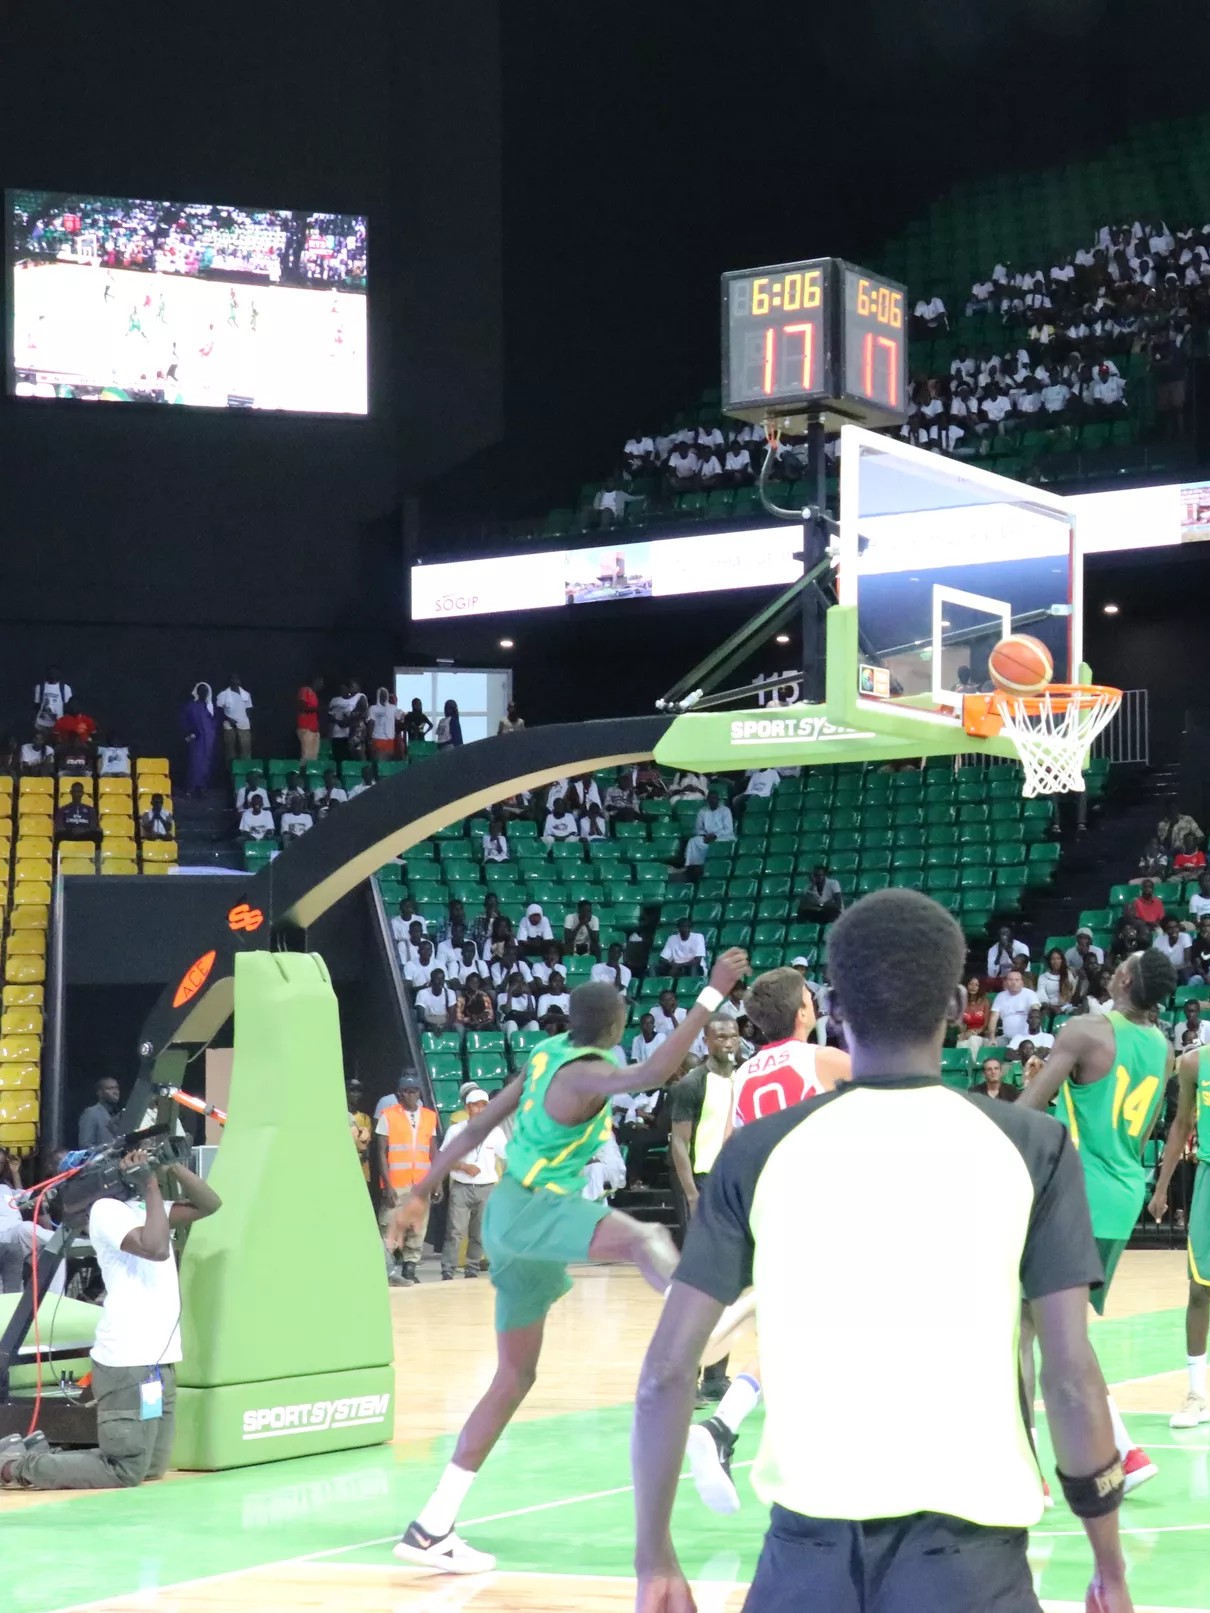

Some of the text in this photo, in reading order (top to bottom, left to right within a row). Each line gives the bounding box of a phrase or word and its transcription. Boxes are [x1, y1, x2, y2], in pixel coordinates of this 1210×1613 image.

[752, 271, 821, 315] 6:06
[857, 279, 903, 328] 6:06
[763, 322, 814, 396] 17
[864, 332, 898, 406] 17
[1112, 1065, 1160, 1137] 14
[243, 1394, 390, 1432] SPORTSYSTEM
